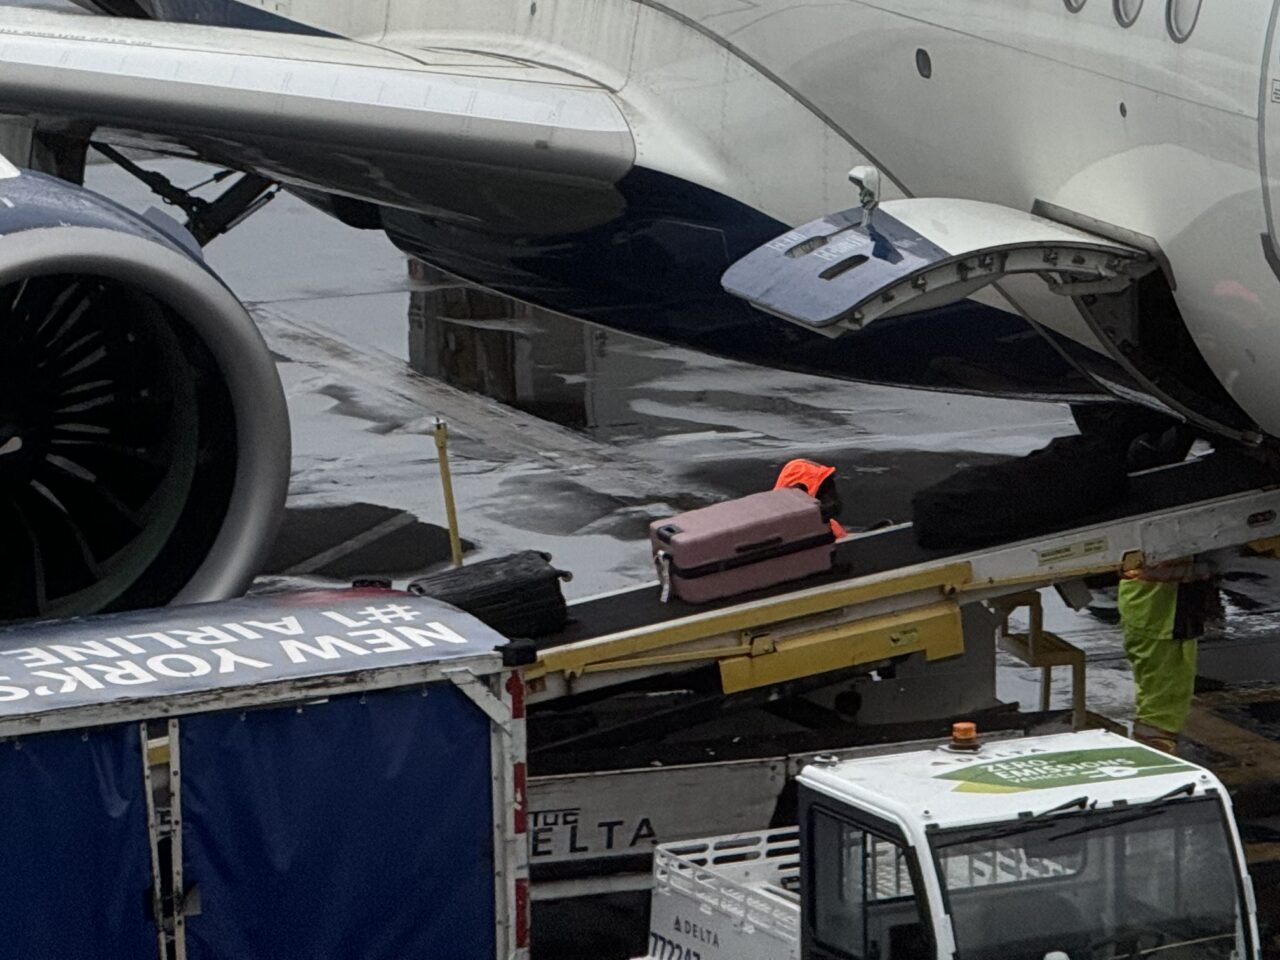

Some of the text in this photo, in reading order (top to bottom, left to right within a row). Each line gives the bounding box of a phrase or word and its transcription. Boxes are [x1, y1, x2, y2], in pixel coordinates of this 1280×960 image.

[0, 603, 422, 668] #1 AIRLINE
[279, 622, 468, 664] NEW
[994, 758, 1136, 779] EMISSIONS
[532, 817, 658, 856] ELTA
[684, 920, 720, 948] DELTA
